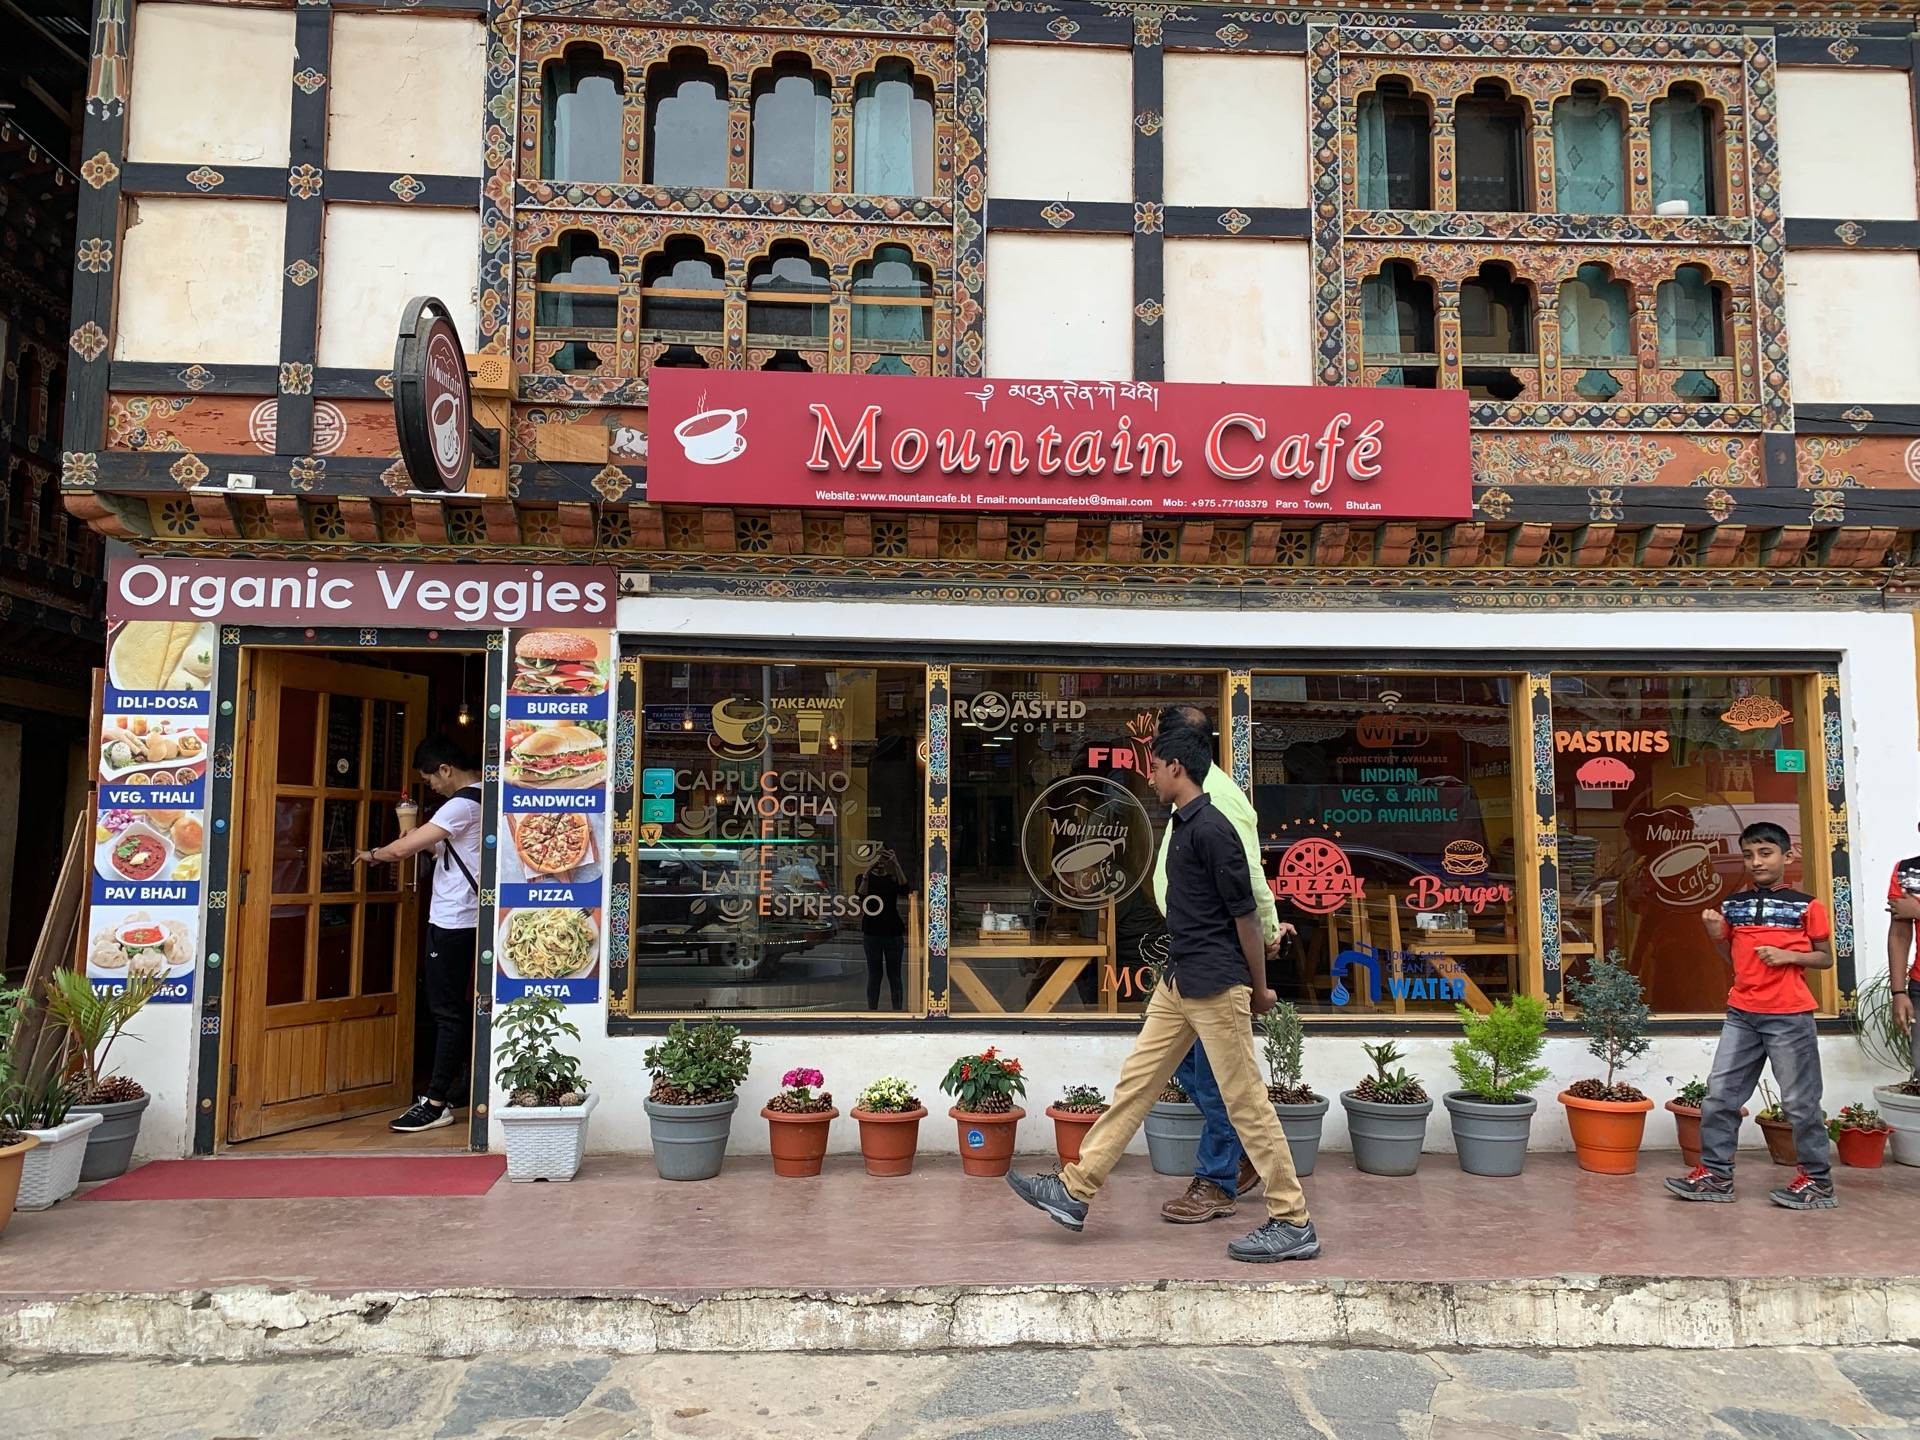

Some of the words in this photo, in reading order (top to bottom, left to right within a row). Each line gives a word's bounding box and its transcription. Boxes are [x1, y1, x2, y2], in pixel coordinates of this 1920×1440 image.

[428, 355, 461, 397] Mountain
[805, 403, 1183, 478] Mountain
[1205, 410, 1384, 496] Café
[1163, 498, 1187, 508] Mob:
[1275, 500, 1299, 509] Paro
[1304, 500, 1333, 511] Town,
[1346, 501, 1382, 511] Bhutan
[119, 563, 355, 616] Organic
[376, 569, 607, 623] Veggies
[116, 695, 199, 710] IDLI-DOSA
[771, 698, 846, 710] TAKEAWAY
[1011, 691, 1049, 701] FRESH
[526, 702, 589, 715] BURGER
[1010, 723, 1086, 733] COFFEE
[1555, 730, 1670, 754] PASTRIES
[1402, 756, 1449, 765] AVAILABLE
[674, 770, 850, 792] CAPPUCCINO
[1360, 768, 1418, 783] INDIAN
[109, 790, 146, 804] VEG.
[150, 791, 195, 804] THALI
[512, 794, 597, 808] SANDWICH
[1340, 788, 1380, 803] VEG.
[1386, 788, 1400, 803] &
[1404, 787, 1439, 803] JAIN
[733, 795, 837, 817] MOCHA
[1324, 808, 1372, 824] FOOD
[1377, 808, 1458, 823] AVAILABLE
[721, 819, 790, 841] CAFE
[1050, 818, 1129, 837] Mountain
[760, 845, 838, 867] FRESH
[702, 870, 773, 892] LATTE
[1080, 859, 1113, 891] Café
[1678, 862, 1709, 894] Café
[104, 886, 138, 900] PAV
[141, 886, 187, 901] BHAJI
[1279, 879, 1352, 892] PIZZA
[528, 889, 575, 902] PIZZA
[1405, 874, 1513, 914] Burger
[759, 895, 884, 917] ESPRESSO
[1438, 963, 1467, 974] PURE
[524, 984, 571, 997] PASTA
[1387, 977, 1467, 1000] WATER
